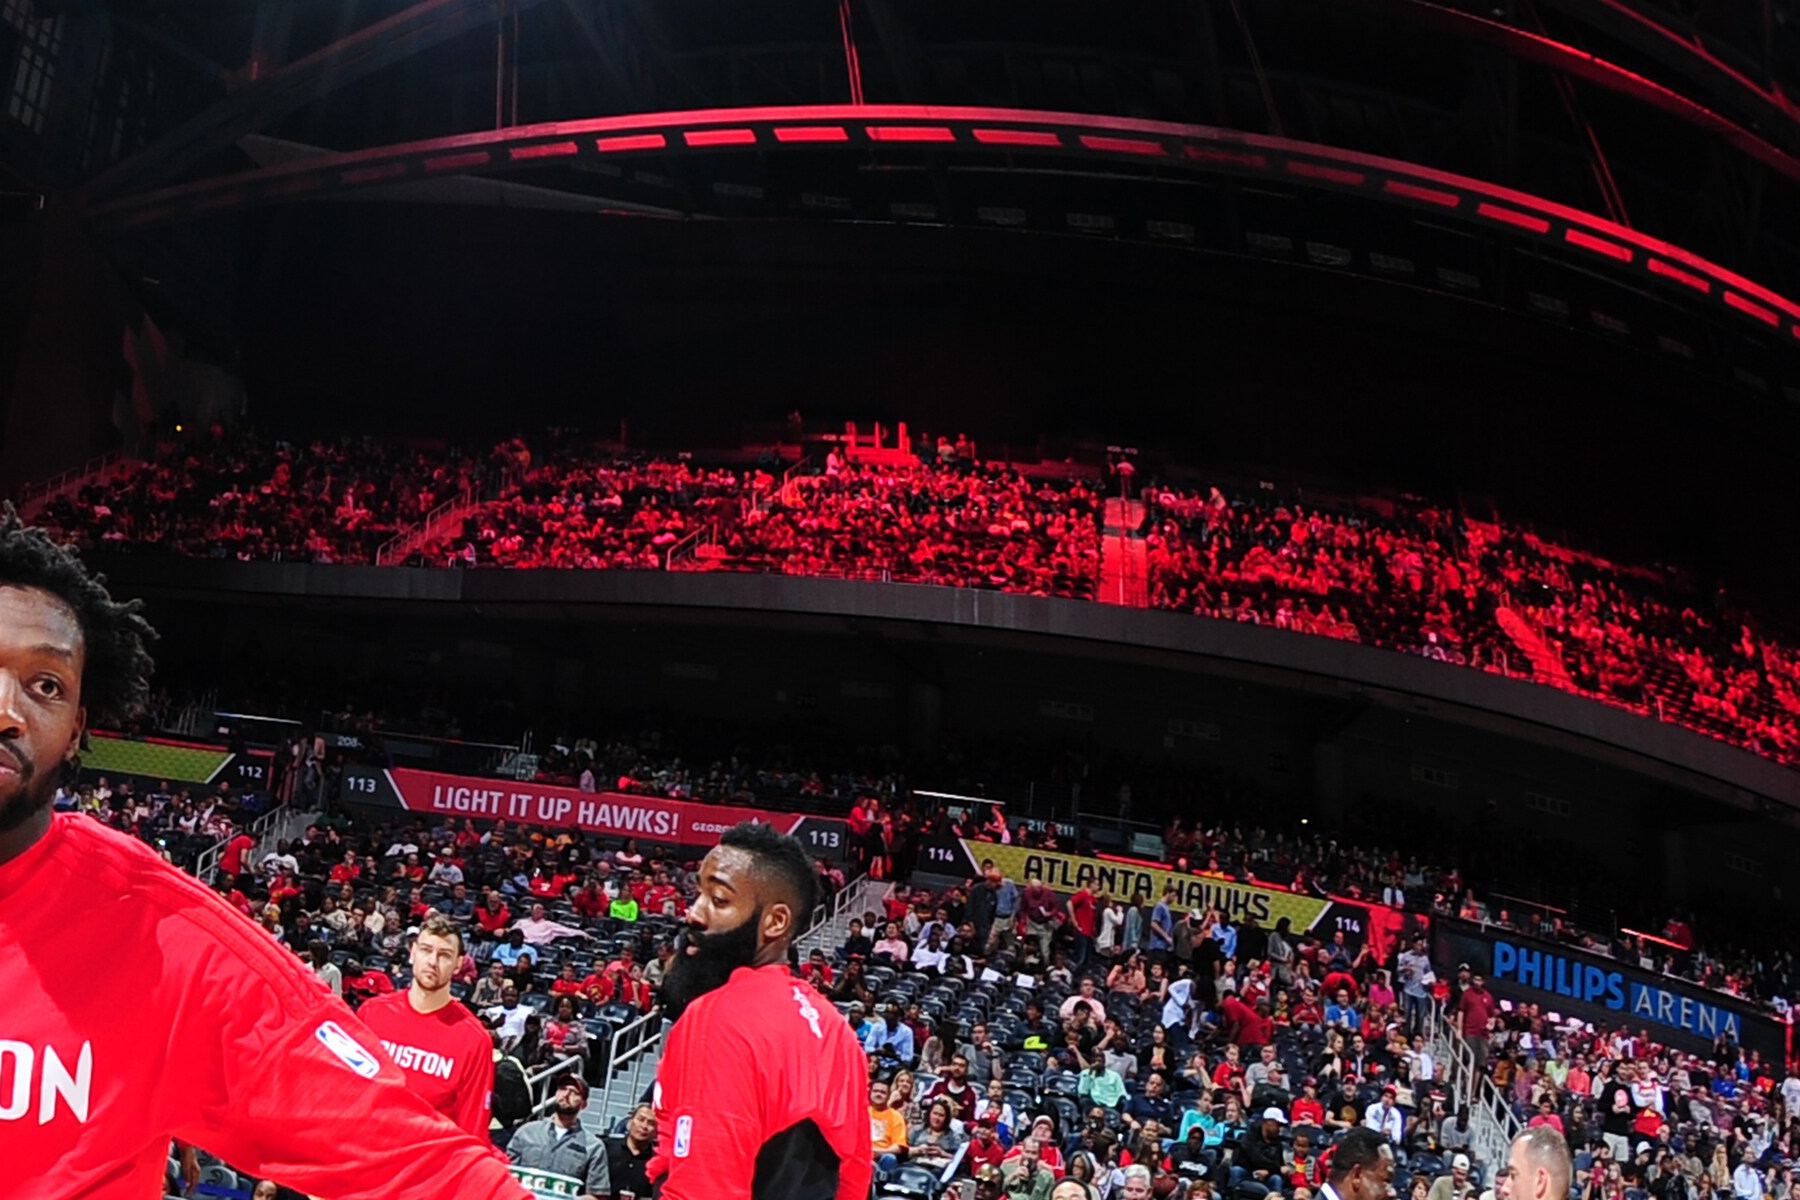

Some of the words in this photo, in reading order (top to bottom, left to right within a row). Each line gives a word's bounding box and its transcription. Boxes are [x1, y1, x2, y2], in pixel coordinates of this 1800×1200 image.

[237, 764, 264, 779] 112
[347, 776, 377, 794] 113
[433, 784, 503, 814] LIGHT
[508, 793, 533, 817] IT
[537, 796, 572, 822] UP
[577, 800, 680, 837] HAWKS!
[809, 829, 840, 848] 113
[927, 847, 955, 862] 114
[1024, 855, 1153, 900] ATLANTA
[1164, 877, 1270, 922] HAWKS
[1333, 915, 1362, 934] 114
[1491, 939, 1626, 1012] PHILIPS
[1633, 983, 1741, 1046] ARENA
